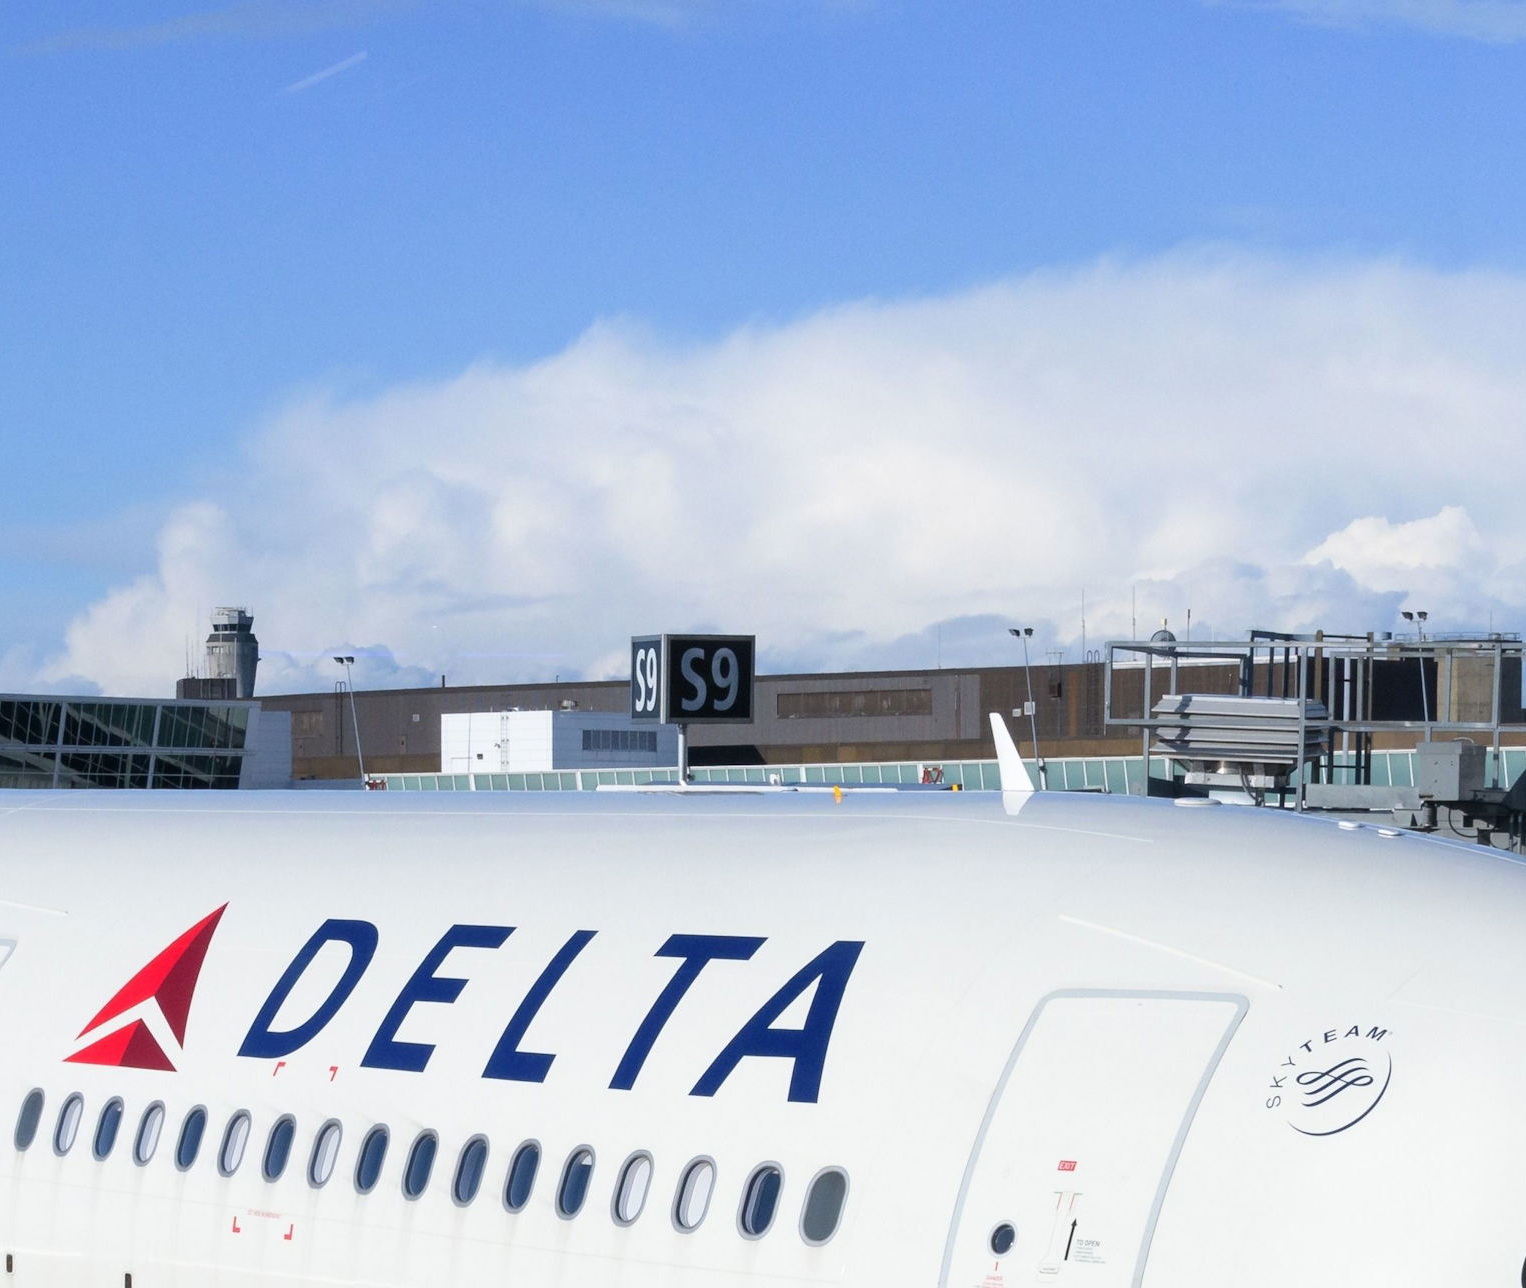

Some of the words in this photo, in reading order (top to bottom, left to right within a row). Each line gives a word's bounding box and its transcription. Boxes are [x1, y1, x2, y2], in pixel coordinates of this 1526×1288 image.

[635, 647, 658, 713] S9
[680, 647, 740, 712] S9
[236, 918, 866, 1104] DELTA
[1265, 1024, 1388, 1109] SKYTEAM
